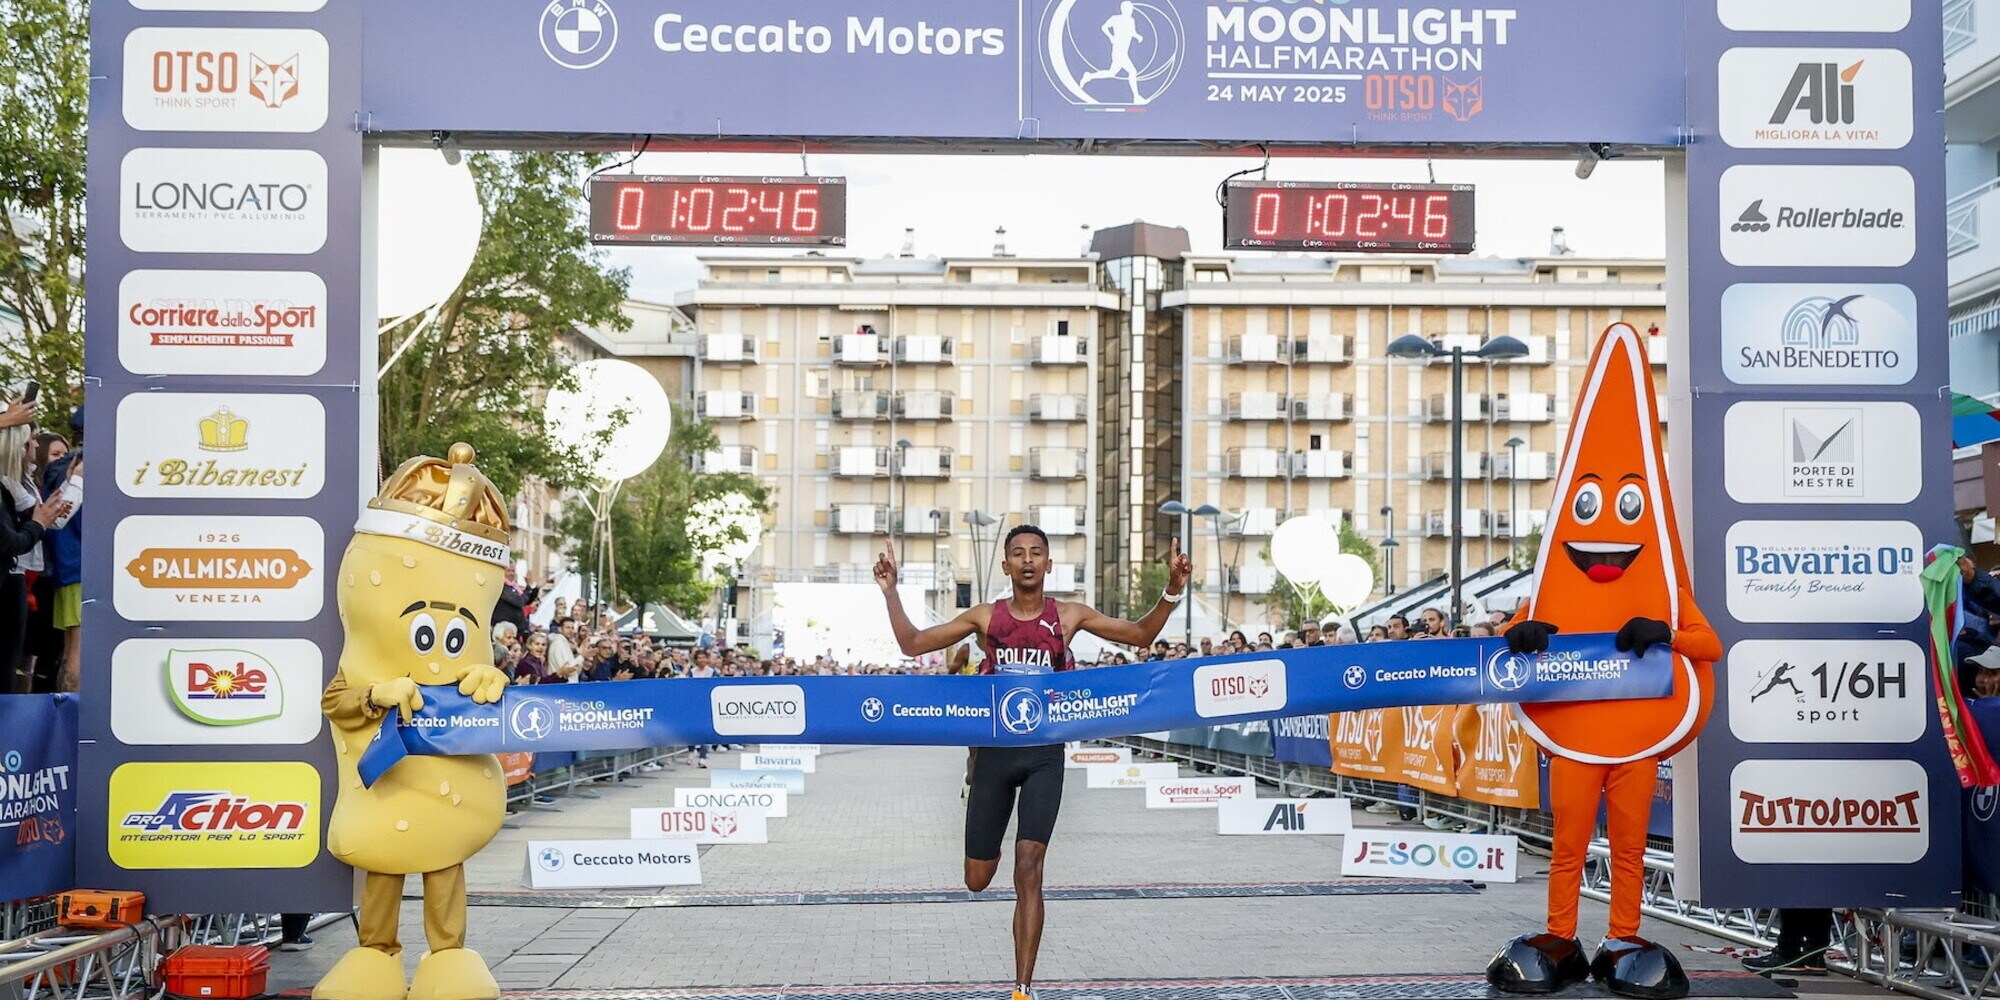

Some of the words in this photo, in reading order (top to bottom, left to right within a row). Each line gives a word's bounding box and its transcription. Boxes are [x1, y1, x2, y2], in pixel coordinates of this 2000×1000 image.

[1206, 7, 1517, 45] MOONLIGHT
[653, 13, 832, 54] Ceccato
[847, 16, 1005, 56] Motors
[1206, 44, 1483, 72] HALFMARATHON
[153, 51, 239, 93] OTSO
[1207, 85, 1234, 102] 24
[1239, 85, 1289, 103] MAY
[1293, 86, 1347, 103] 2025
[1365, 74, 1435, 110] OTSO
[154, 98, 192, 108] THINK
[195, 98, 237, 109] SPORT
[1367, 112, 1398, 121] THINK
[1400, 112, 1433, 121] SPORT
[1755, 130, 1820, 140] MIGLIORA
[1825, 130, 1840, 140] LA
[1846, 130, 1878, 140] VITA!
[135, 182, 308, 211] LONGATO
[214, 212, 235, 220] PVC
[242, 213, 305, 221] ALLUMINIO
[1776, 207, 1903, 228] Rollerblade
[129, 303, 219, 326] Corriere
[220, 312, 252, 327] dello
[253, 304, 316, 335] Sport
[158, 334, 236, 344] SEMPLICEMENTE
[239, 335, 285, 345] PASSIONE
[133, 461, 151, 485] i
[158, 459, 307, 487] Bibanesi
[1793, 466, 1836, 476] PORTE
[1841, 466, 1855, 476] DI
[1793, 478, 1855, 488] MESTRE
[198, 534, 241, 543] 1926
[403, 521, 419, 534] i
[423, 525, 505, 560] Bibanesi
[1736, 545, 1872, 575] Bavaria
[152, 557, 287, 580] PALMISANO
[1743, 578, 1801, 598] Family
[1807, 579, 1865, 593] Brewed
[175, 594, 262, 603] VENEZIA
[996, 648, 1052, 667] POLIZIA
[1375, 669, 1427, 682] Ceccato
[1429, 666, 1477, 678] Motors
[1536, 659, 1630, 673] MOONLIGHT
[188, 662, 267, 693] Dole
[1536, 671, 1621, 682] HALFMARATHON
[1811, 661, 1906, 703] 1/6H
[1212, 676, 1245, 696] OTSO
[718, 701, 797, 715] LONGATO
[892, 703, 943, 717] Ceccato
[946, 704, 990, 717] Motors
[1048, 694, 1138, 714] MOONLIGHT
[451, 715, 499, 728] Motors
[560, 708, 654, 724] MOONLIGHT
[1048, 707, 1130, 723] HALFMARATHON
[1796, 708, 1860, 724] sport
[560, 720, 644, 731] HALFMARATHON
[754, 754, 801, 766] Bavaria
[1160, 784, 1199, 795] Corriere
[1214, 784, 1242, 797] Sport
[686, 794, 773, 807] LONGATO
[1739, 790, 1921, 827] TUTTOSPORT
[661, 811, 706, 832] OTSO
[262, 833, 302, 841] SPORT
[573, 852, 634, 866] Ceccato
[638, 852, 692, 865] Motors
[1354, 841, 1504, 871] JESOLO.it
